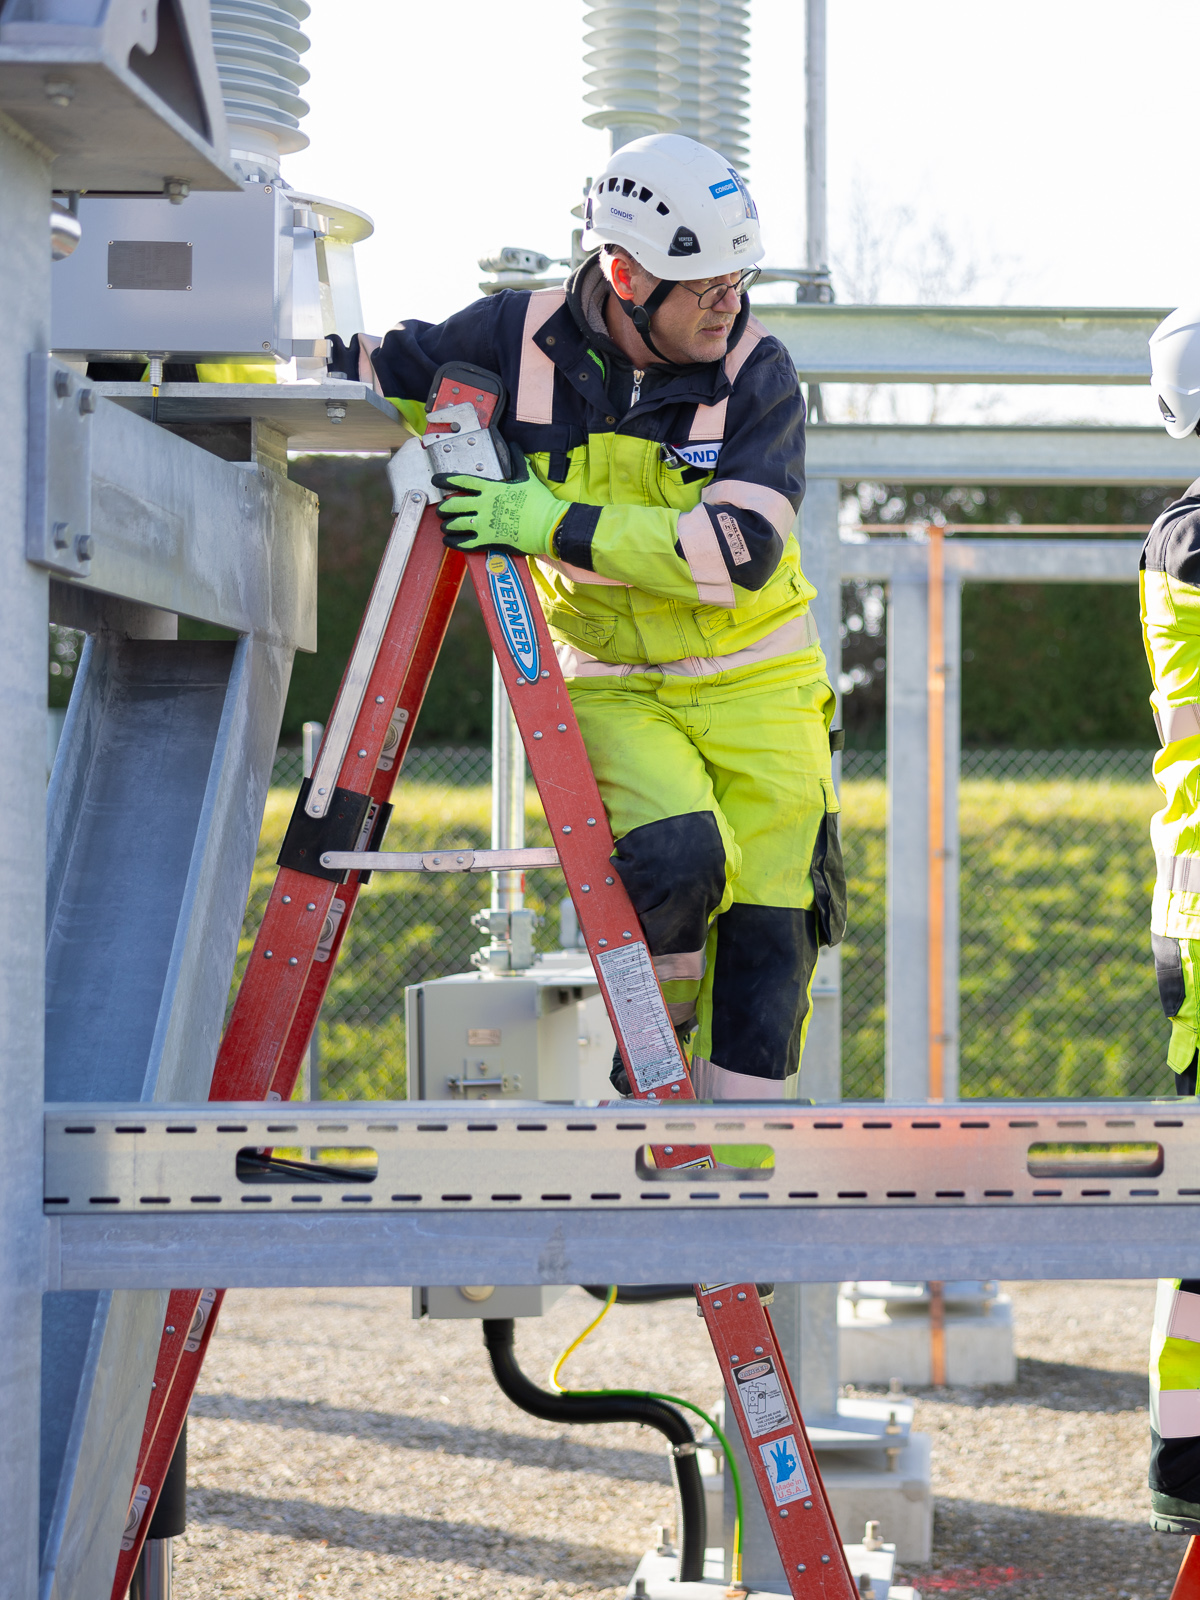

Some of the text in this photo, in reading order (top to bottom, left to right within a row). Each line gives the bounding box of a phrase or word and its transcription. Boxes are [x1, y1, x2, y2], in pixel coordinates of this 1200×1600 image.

[732, 234, 749, 250] PETZL
[489, 494, 501, 530] MAPA
[497, 569, 532, 655] WERNER
[740, 1363, 768, 1379] DANGER
[775, 1478, 802, 1492] Made in
[777, 1486, 805, 1499] U.S.A.
